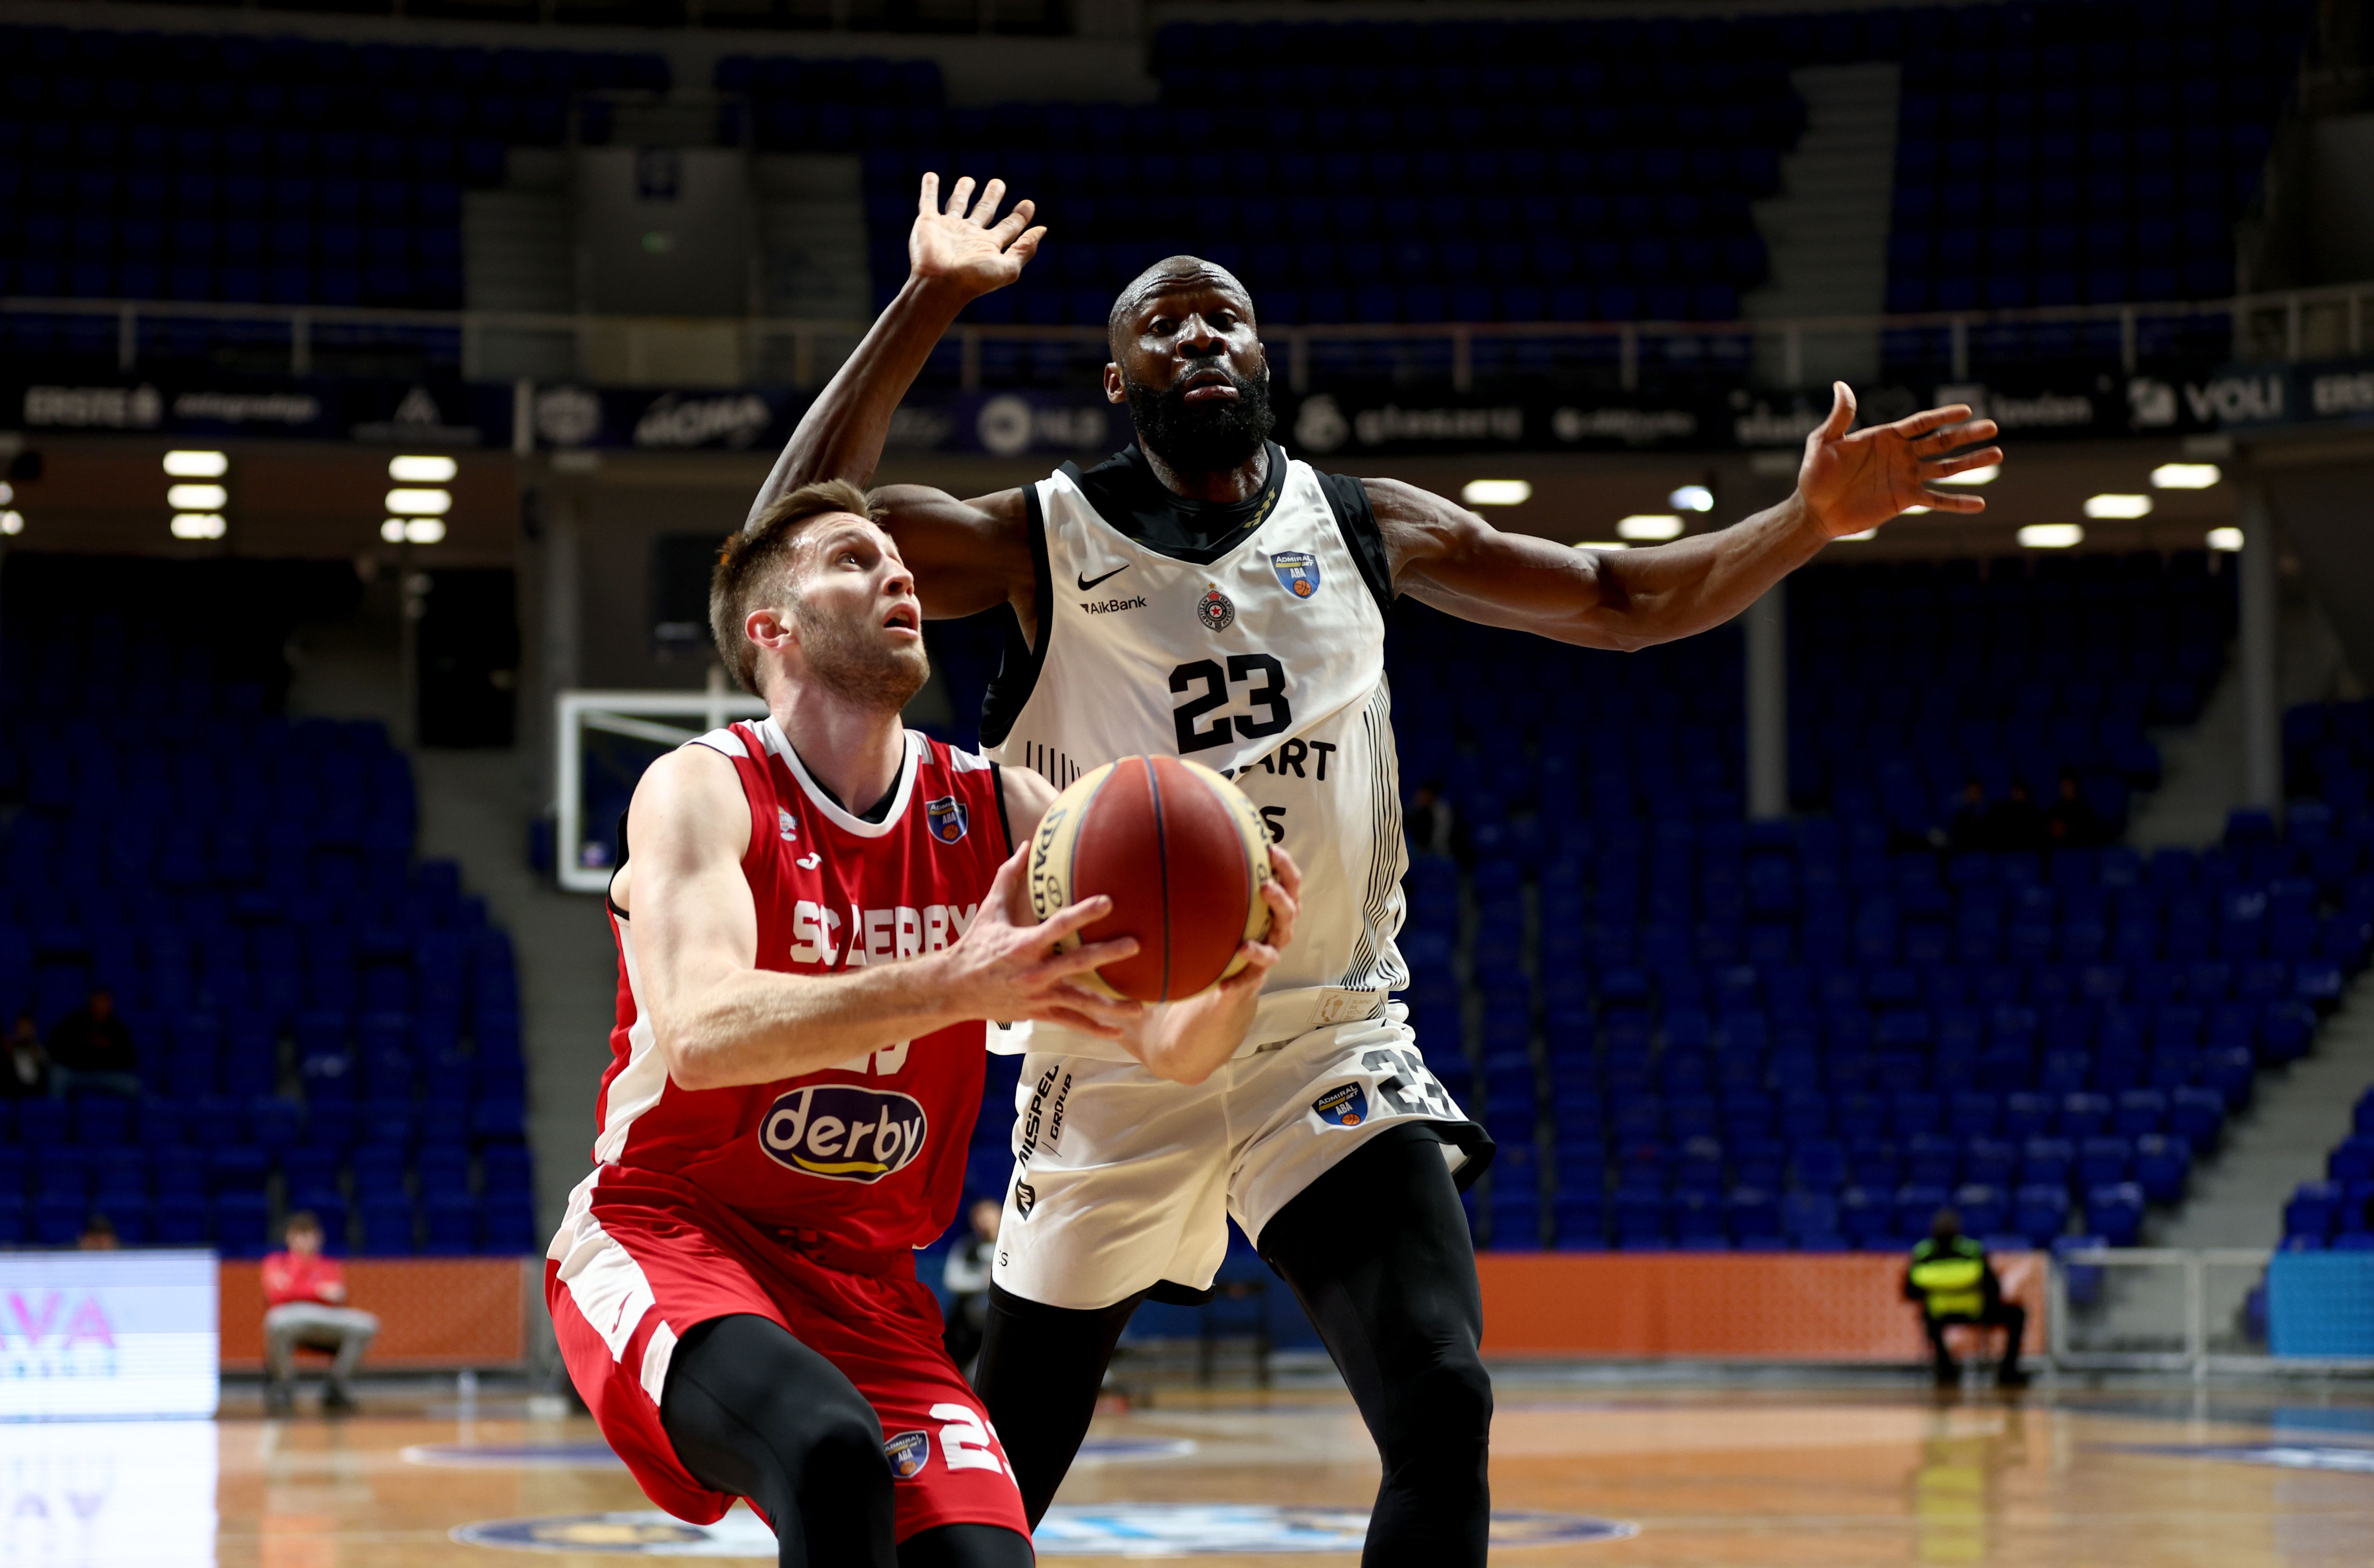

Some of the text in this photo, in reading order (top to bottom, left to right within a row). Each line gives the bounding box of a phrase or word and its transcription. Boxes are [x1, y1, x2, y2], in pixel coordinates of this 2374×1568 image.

[1290, 567, 1307, 579] ABA
[1091, 595, 1147, 615] AikBank
[1168, 653, 1292, 755] 23
[790, 900, 841, 966] SC
[1050, 1073, 1072, 1140] GROUP
[1319, 1085, 1358, 1106] ADMIRAL
[1335, 1101, 1353, 1116] ABA
[1361, 1049, 1459, 1119] 23
[766, 1088, 921, 1170] derby
[0, 1291, 116, 1352] VA
[898, 1448, 913, 1462] ABA
